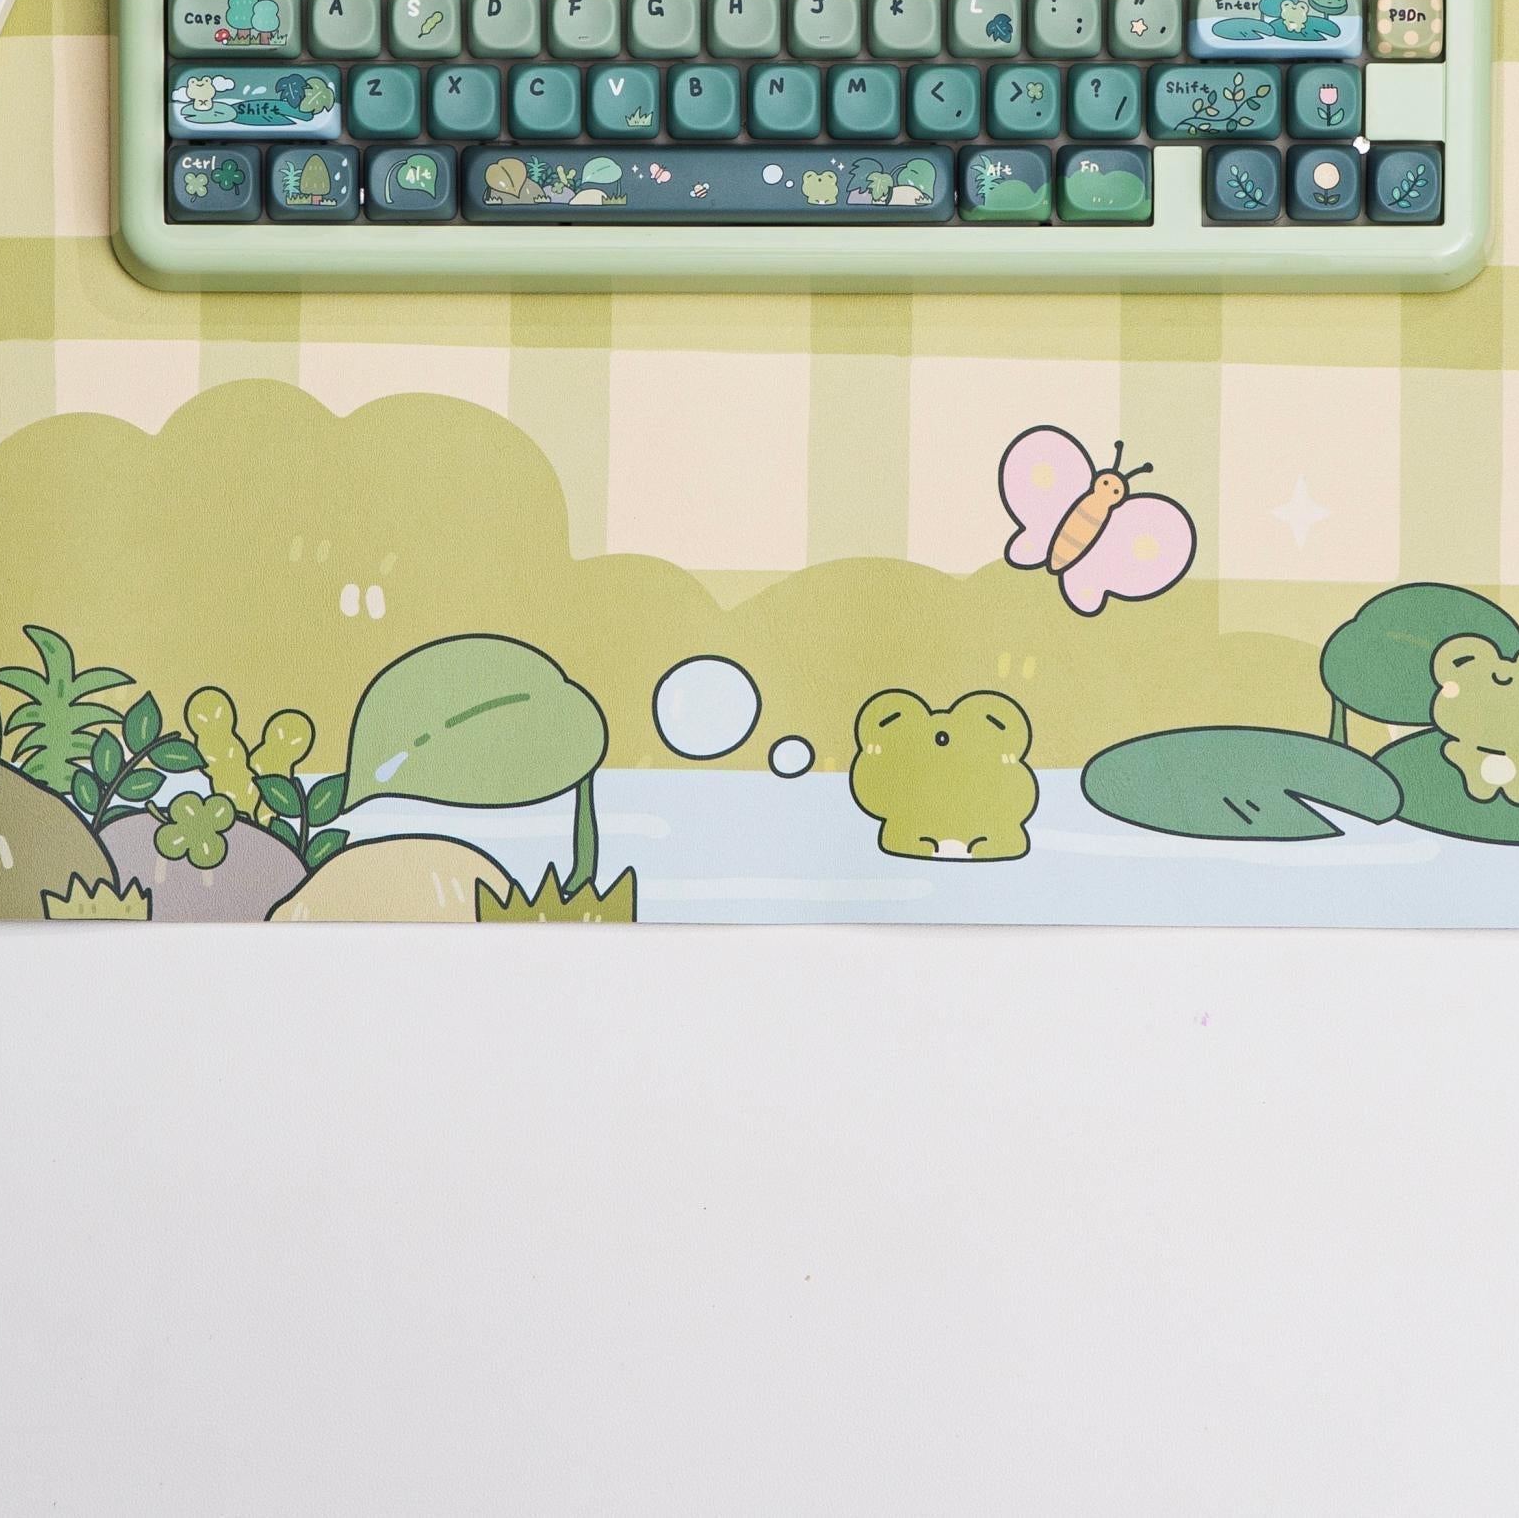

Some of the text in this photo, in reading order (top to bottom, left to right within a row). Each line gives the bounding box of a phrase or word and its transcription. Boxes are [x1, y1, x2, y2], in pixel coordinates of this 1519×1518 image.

[184, 11, 222, 28] Caps
[1389, 7, 1426, 25] PgDn
[368, 79, 382, 96] Z
[448, 76, 462, 95] X
[529, 78, 544, 97] C
[608, 77, 625, 96] V
[689, 77, 703, 97] B
[769, 76, 784, 95] N
[847, 78, 866, 93] M
[931, 82, 944, 103] <
[1011, 81, 1023, 100] >
[1090, 78, 1101, 98] ?
[1165, 80, 1210, 96] Shift
[237, 101, 282, 118] Shift
[1114, 96, 1127, 122] /
[181, 155, 215, 170] Ctrl
[986, 162, 1012, 177] Alt
[1080, 160, 1099, 174] Fn
[405, 167, 431, 182] Alt
